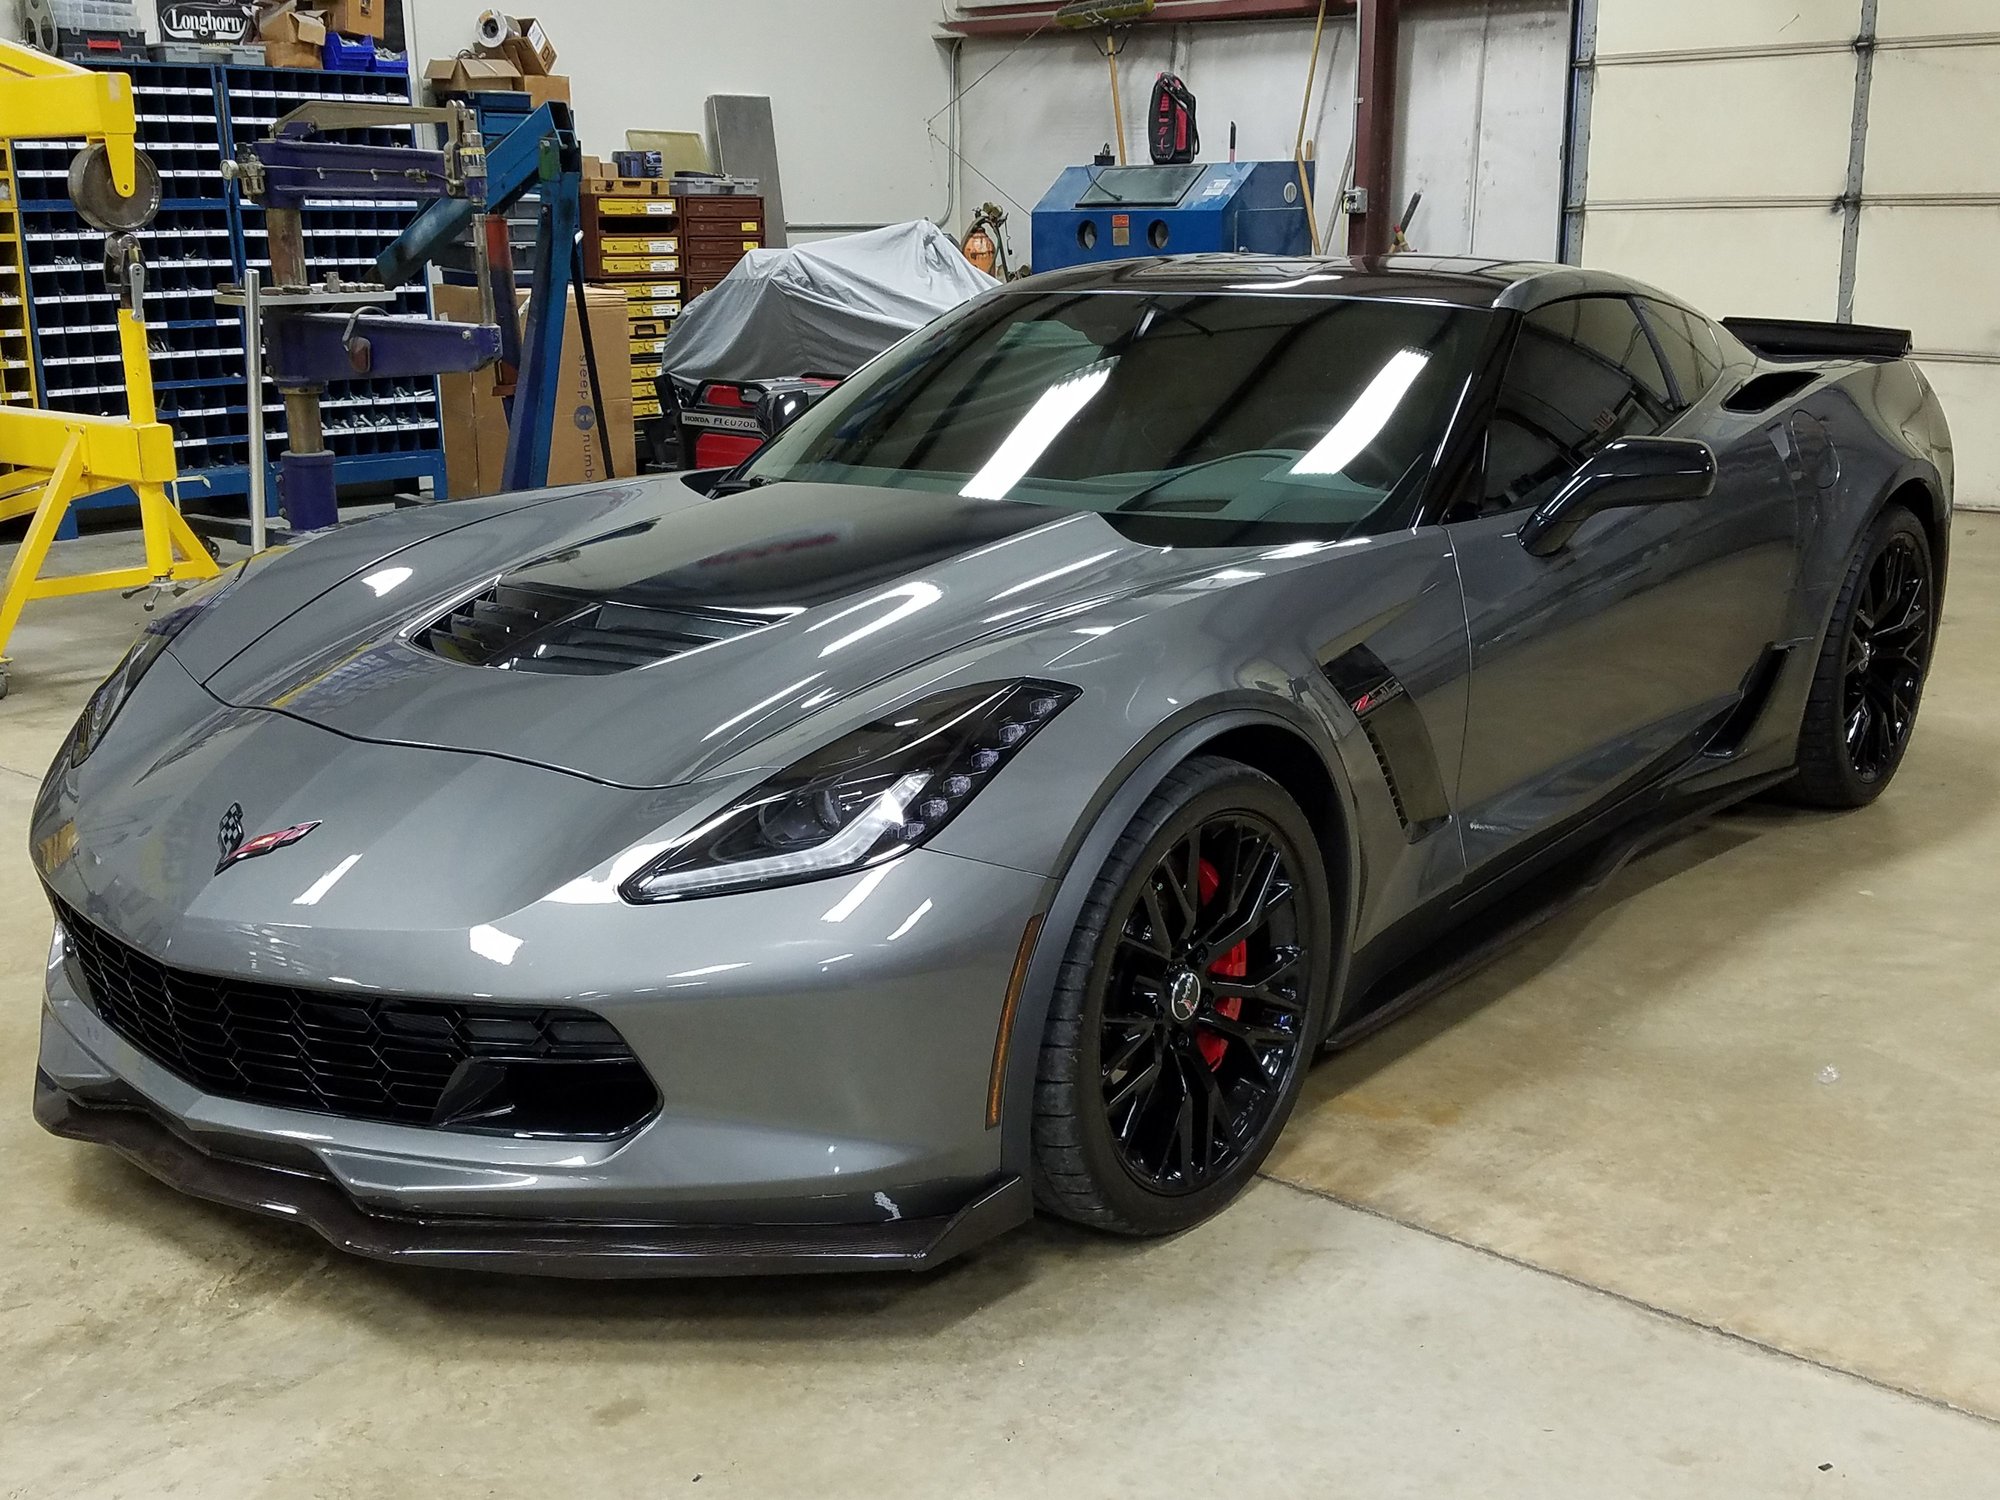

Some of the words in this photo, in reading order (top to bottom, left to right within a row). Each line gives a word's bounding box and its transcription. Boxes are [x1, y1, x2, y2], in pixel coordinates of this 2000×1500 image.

[170, 9, 242, 36] Longhorn
[577, 354, 589, 400] sleep
[583, 433, 595, 481] numb
[684, 415, 710, 424] HONDA
[724, 418, 760, 429] EU700
